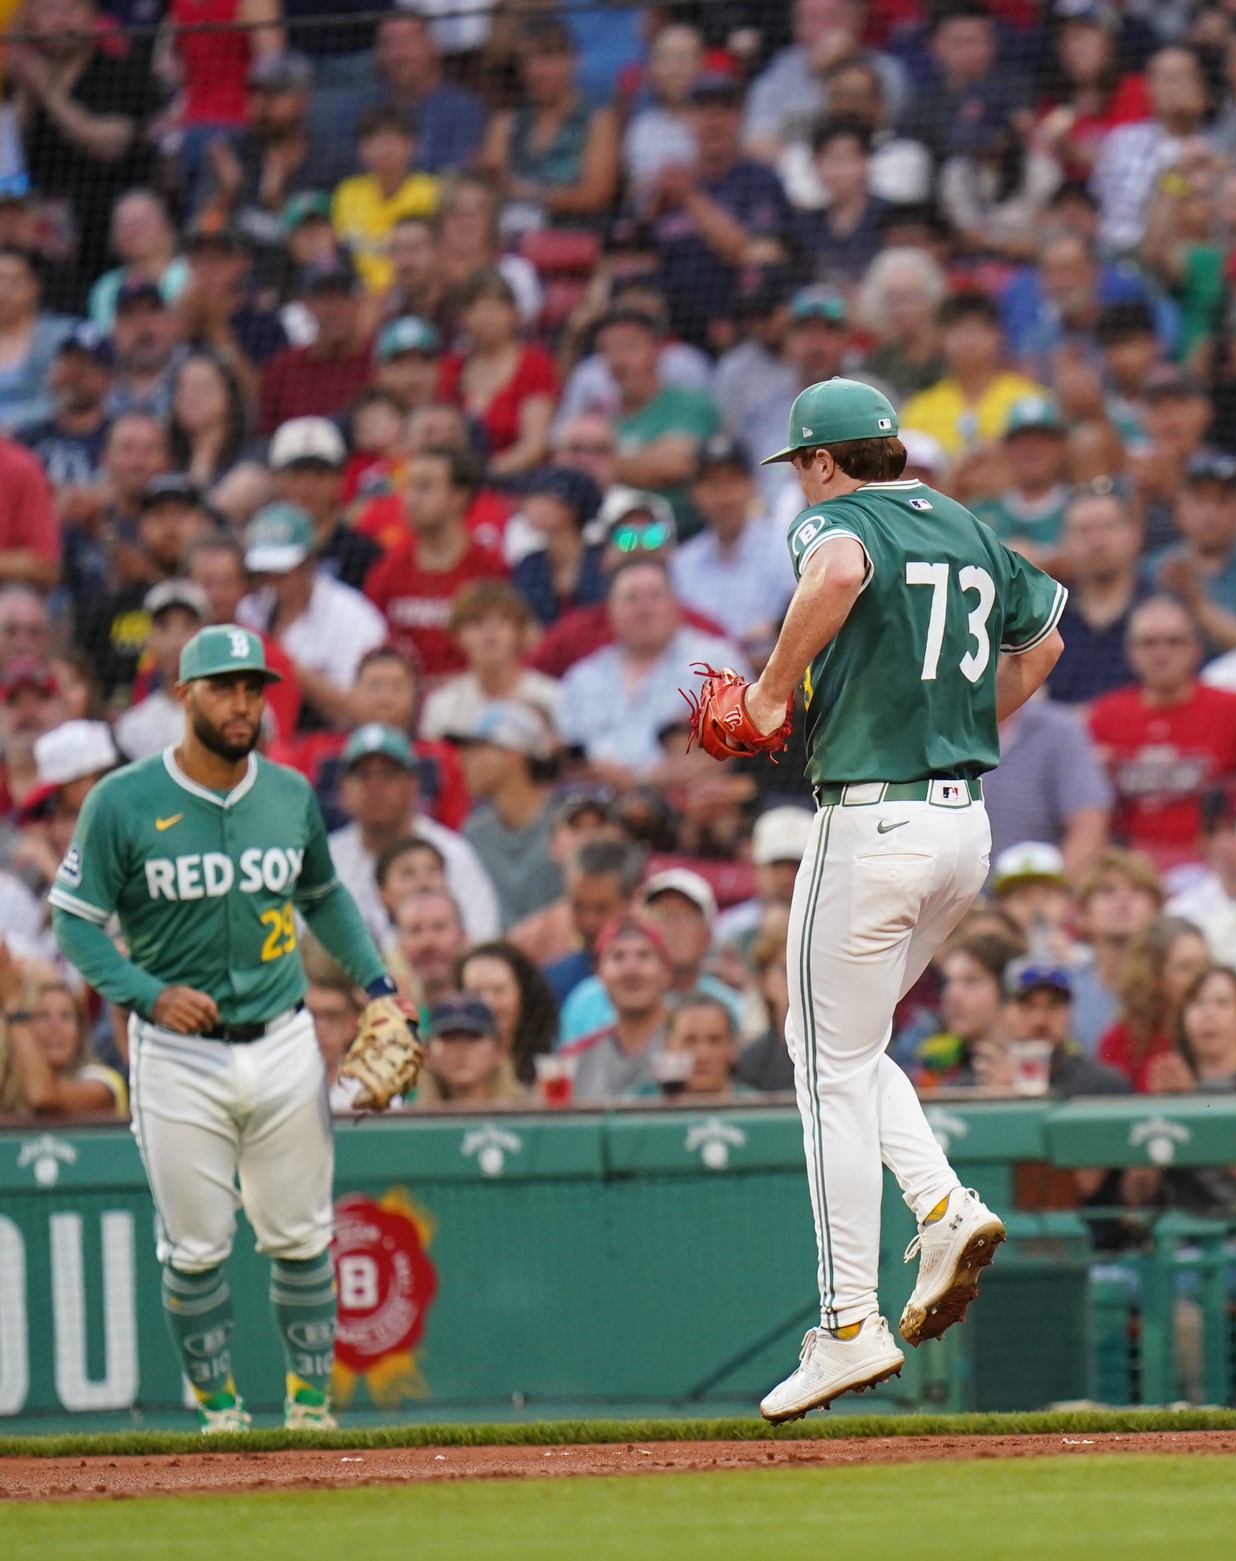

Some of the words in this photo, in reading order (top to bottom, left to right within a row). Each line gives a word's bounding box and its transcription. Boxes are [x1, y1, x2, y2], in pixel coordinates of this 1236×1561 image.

[800, 523, 818, 546] B
[226, 630, 250, 659] B
[905, 561, 996, 684] 73
[144, 852, 235, 901] RED
[260, 901, 297, 962] 29
[338, 1253, 379, 1310] B
